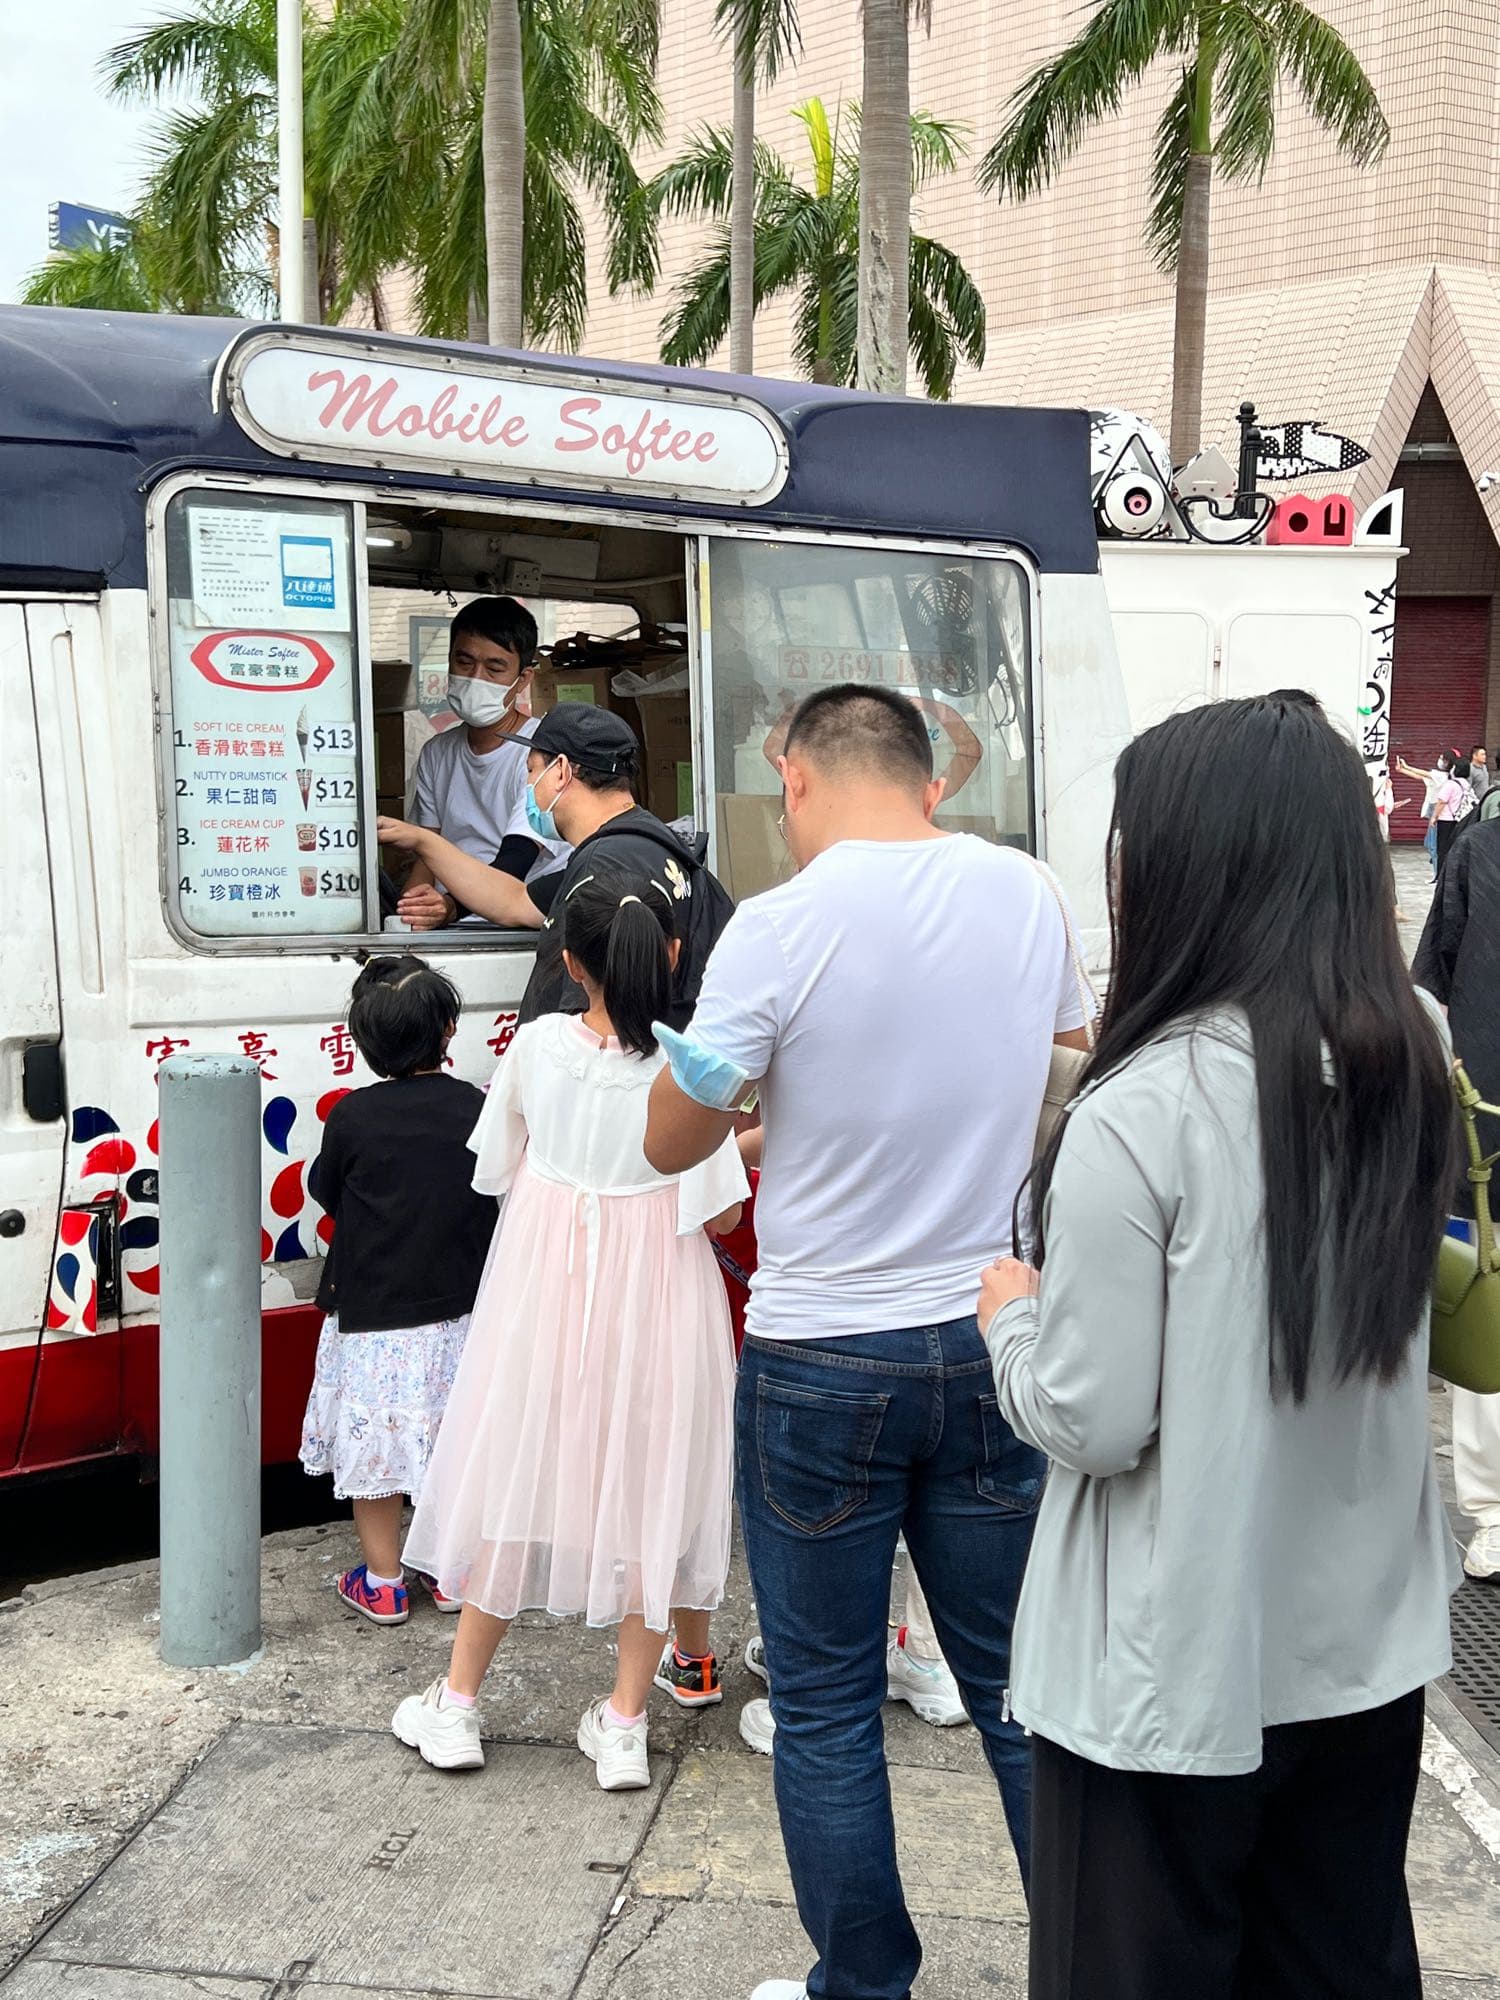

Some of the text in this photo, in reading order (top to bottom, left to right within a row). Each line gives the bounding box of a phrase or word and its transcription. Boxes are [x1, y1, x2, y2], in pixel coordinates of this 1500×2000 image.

[307, 369, 719, 475] Mobile Softee
[285, 580, 332, 594] 八達通
[285, 593, 333, 603] OCTOPUS
[228, 643, 300, 662] Mister Softee
[230, 663, 299, 678] 富豪雪糕
[821, 651, 886, 681] 2691
[193, 722, 284, 734] SOFT ICE CREAM
[174, 730, 192, 748] 1.
[313, 725, 354, 752] $13
[195, 739, 285, 757] 香滑軟雪糕
[193, 771, 288, 781] NUTTY DRUMSTICK
[175, 778, 194, 797] 2.
[206, 787, 277, 805] 果仁甜筒
[316, 778, 356, 802] $12
[200, 819, 285, 829] ICE CREAM CUP
[177, 828, 195, 846] 3.
[217, 836, 270, 853] 蓮花杯
[318, 826, 358, 850] $10
[200, 867, 288, 877] JUMBO ORANGE
[178, 877, 197, 894] 4.
[320, 870, 360, 894] $10
[209, 884, 281, 901] 珍寶橙冰
